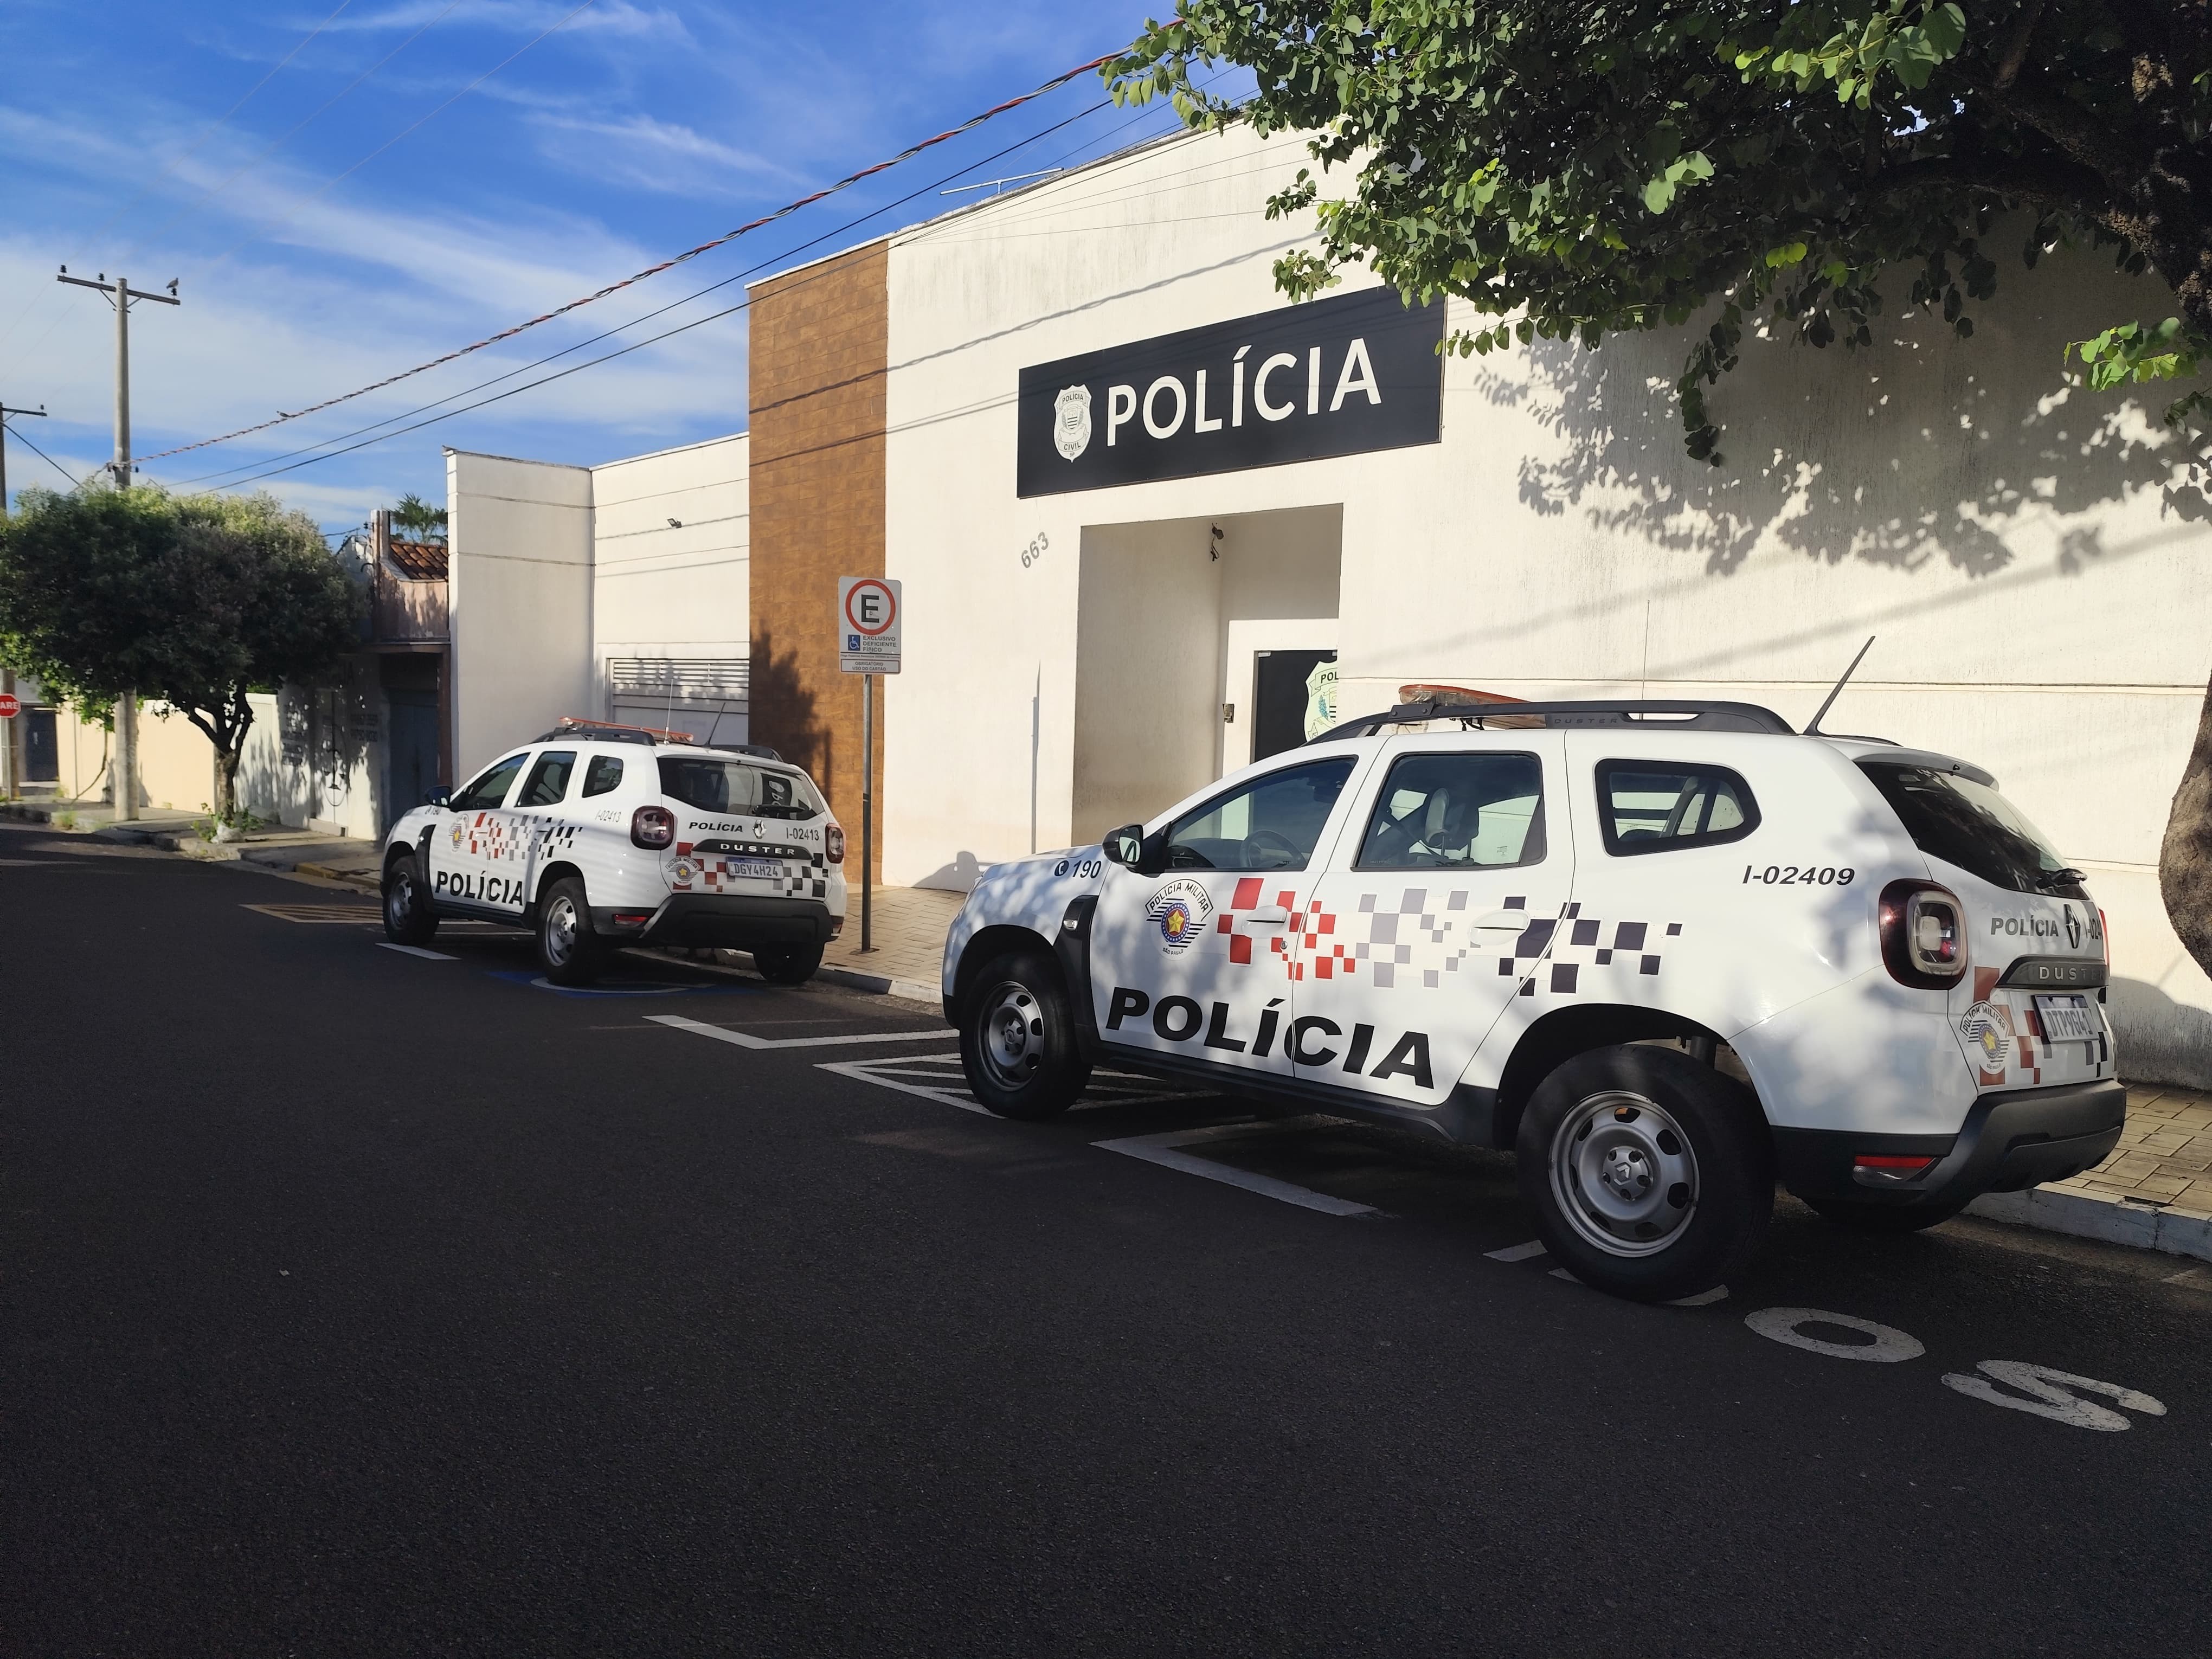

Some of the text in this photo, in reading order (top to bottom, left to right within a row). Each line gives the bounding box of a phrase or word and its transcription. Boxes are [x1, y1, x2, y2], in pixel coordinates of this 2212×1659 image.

[1062, 392, 1084, 404] POLÍCIA
[1107, 338, 1382, 447] POLÍCIA
[1064, 442, 1081, 451] CIVIL
[1021, 531, 1049, 568] 663
[861, 594, 879, 623] E
[0, 702, 18, 710] ARE
[689, 821, 743, 833] POLÍCIA
[786, 827, 819, 841] I-02413
[719, 843, 795, 856] DUSTER
[734, 863, 779, 877] DGY4H24
[1072, 860, 1101, 879] 190
[1742, 865, 1856, 885] I-02409
[435, 870, 524, 907] POLÍCIA
[1185, 882, 1209, 913] MILITAR
[1990, 915, 2059, 937] POLÍCIA
[1982, 1005, 2006, 1031] MILITAR
[1106, 987, 1435, 1090] POLÍCIA
